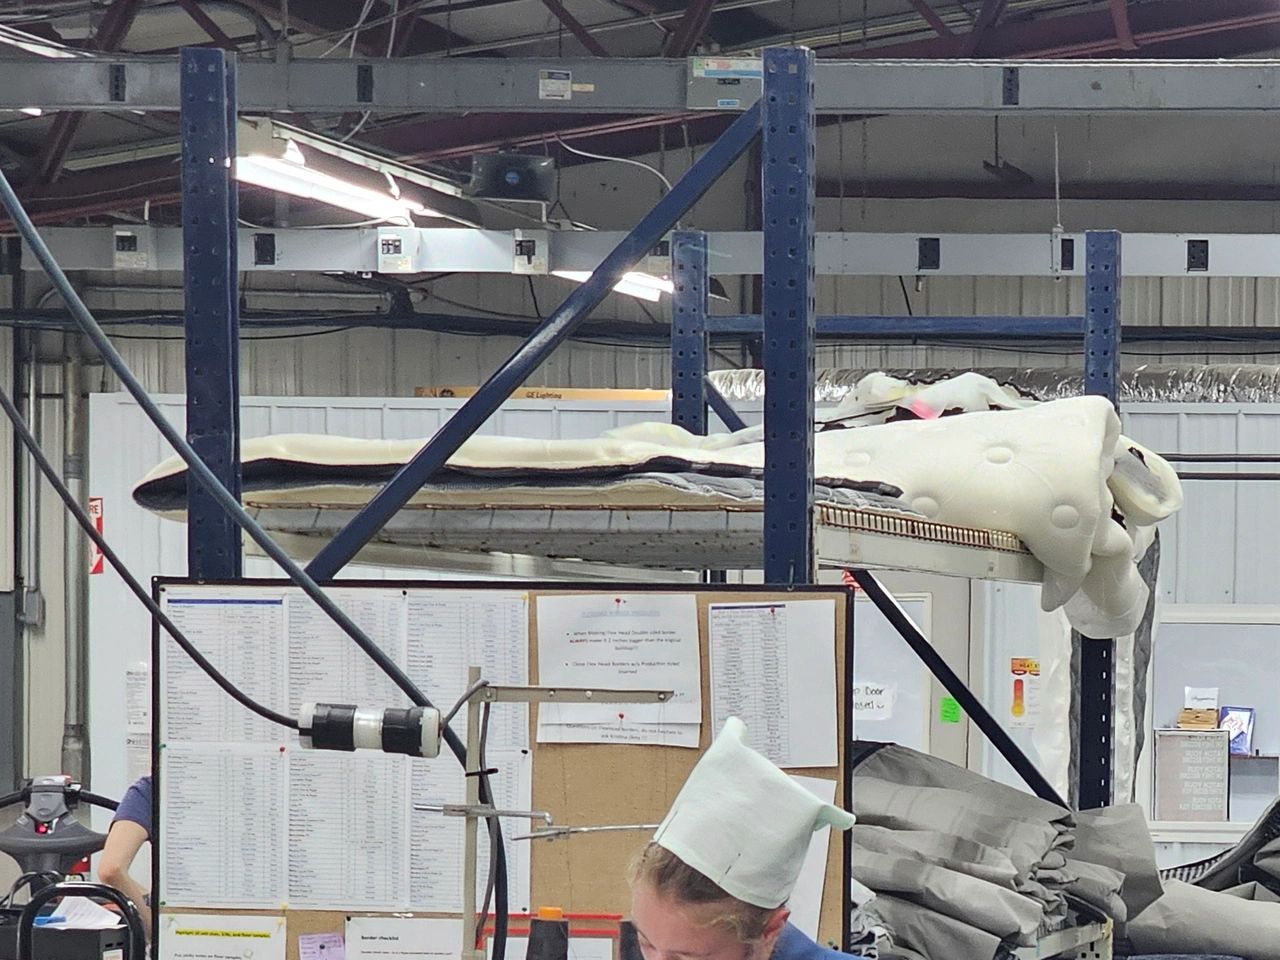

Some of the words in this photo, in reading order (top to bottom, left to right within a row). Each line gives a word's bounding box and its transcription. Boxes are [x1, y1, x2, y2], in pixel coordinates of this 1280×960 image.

[526, 391, 535, 399] GE
[536, 391, 562, 400] Lighting
[865, 686, 884, 695] Door
